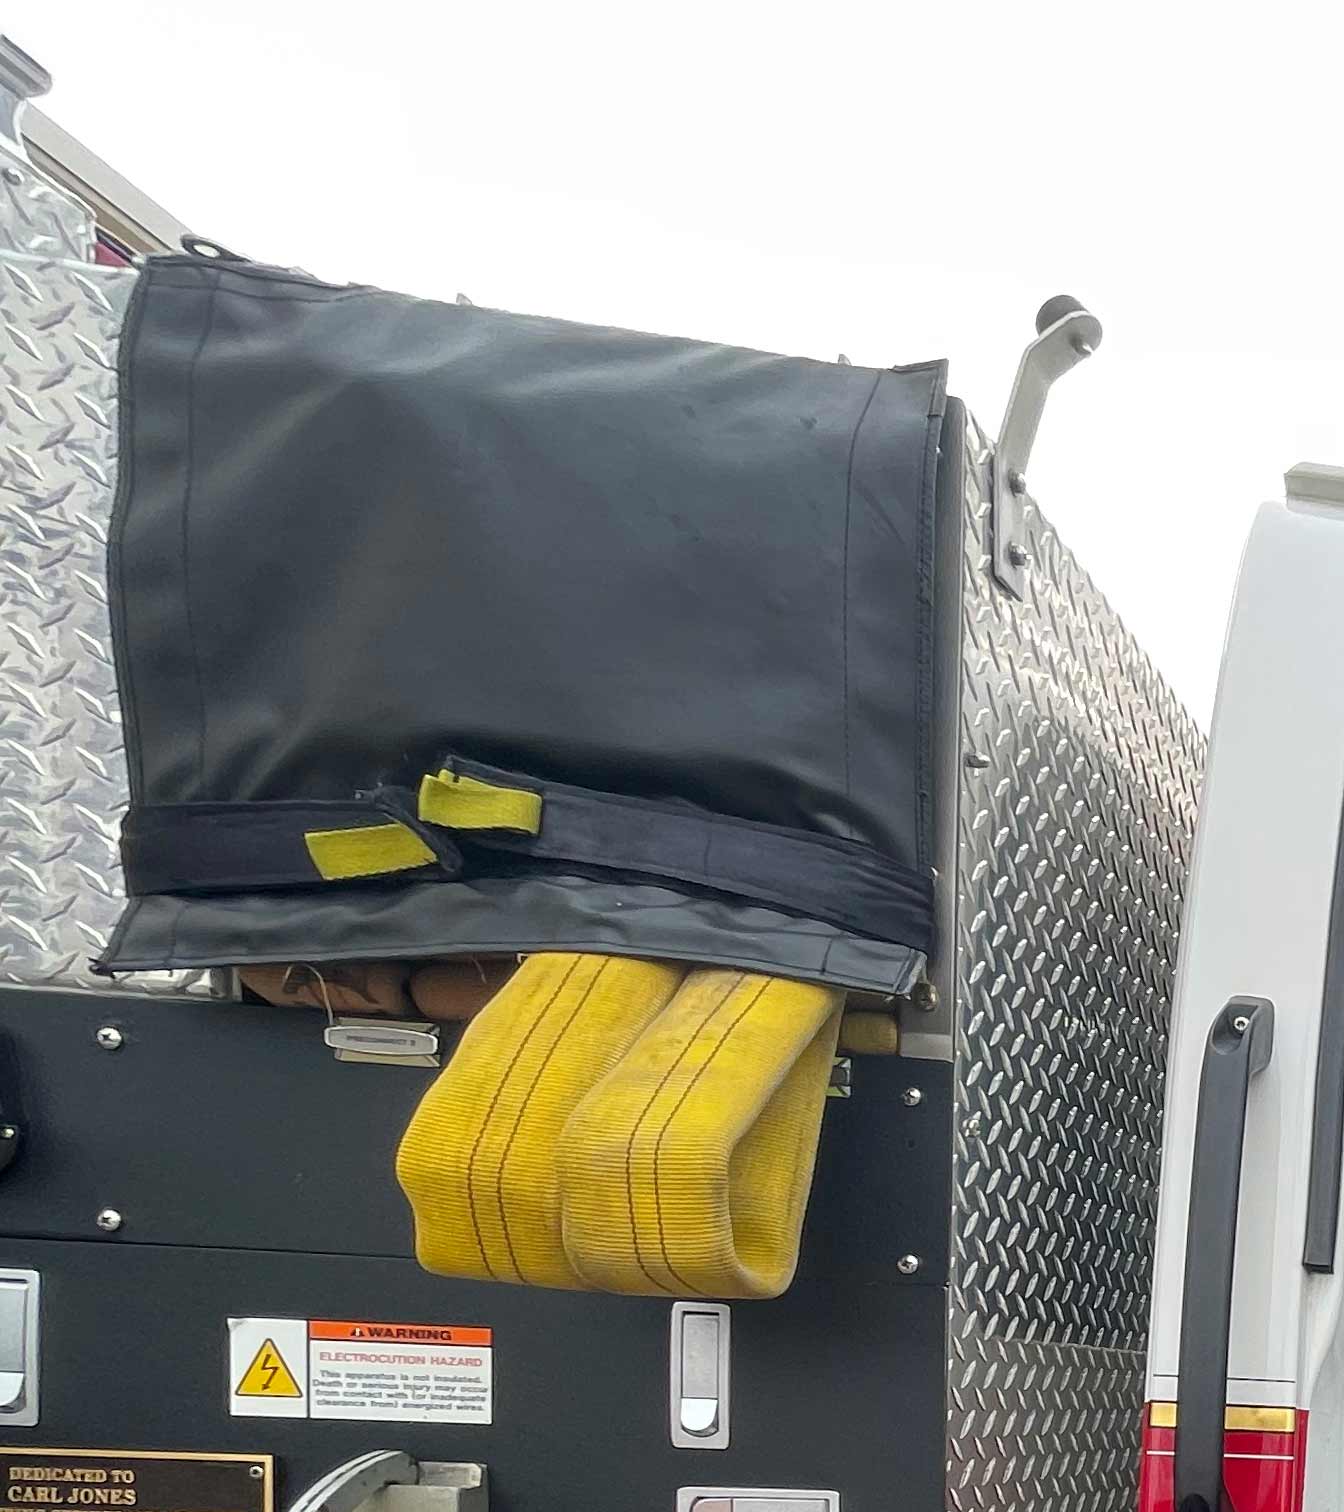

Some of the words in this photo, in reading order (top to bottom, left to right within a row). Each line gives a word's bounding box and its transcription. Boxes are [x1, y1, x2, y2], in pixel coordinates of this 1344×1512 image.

[368, 1327, 452, 1341] WARNING
[319, 1351, 426, 1365] ELECTROCUTION
[430, 1356, 483, 1367] HAZARD
[9, 1467, 107, 1483] DEDICATED
[111, 1470, 135, 1484] TO
[7, 1485, 63, 1504] CARL
[67, 1488, 137, 1506] JONES
